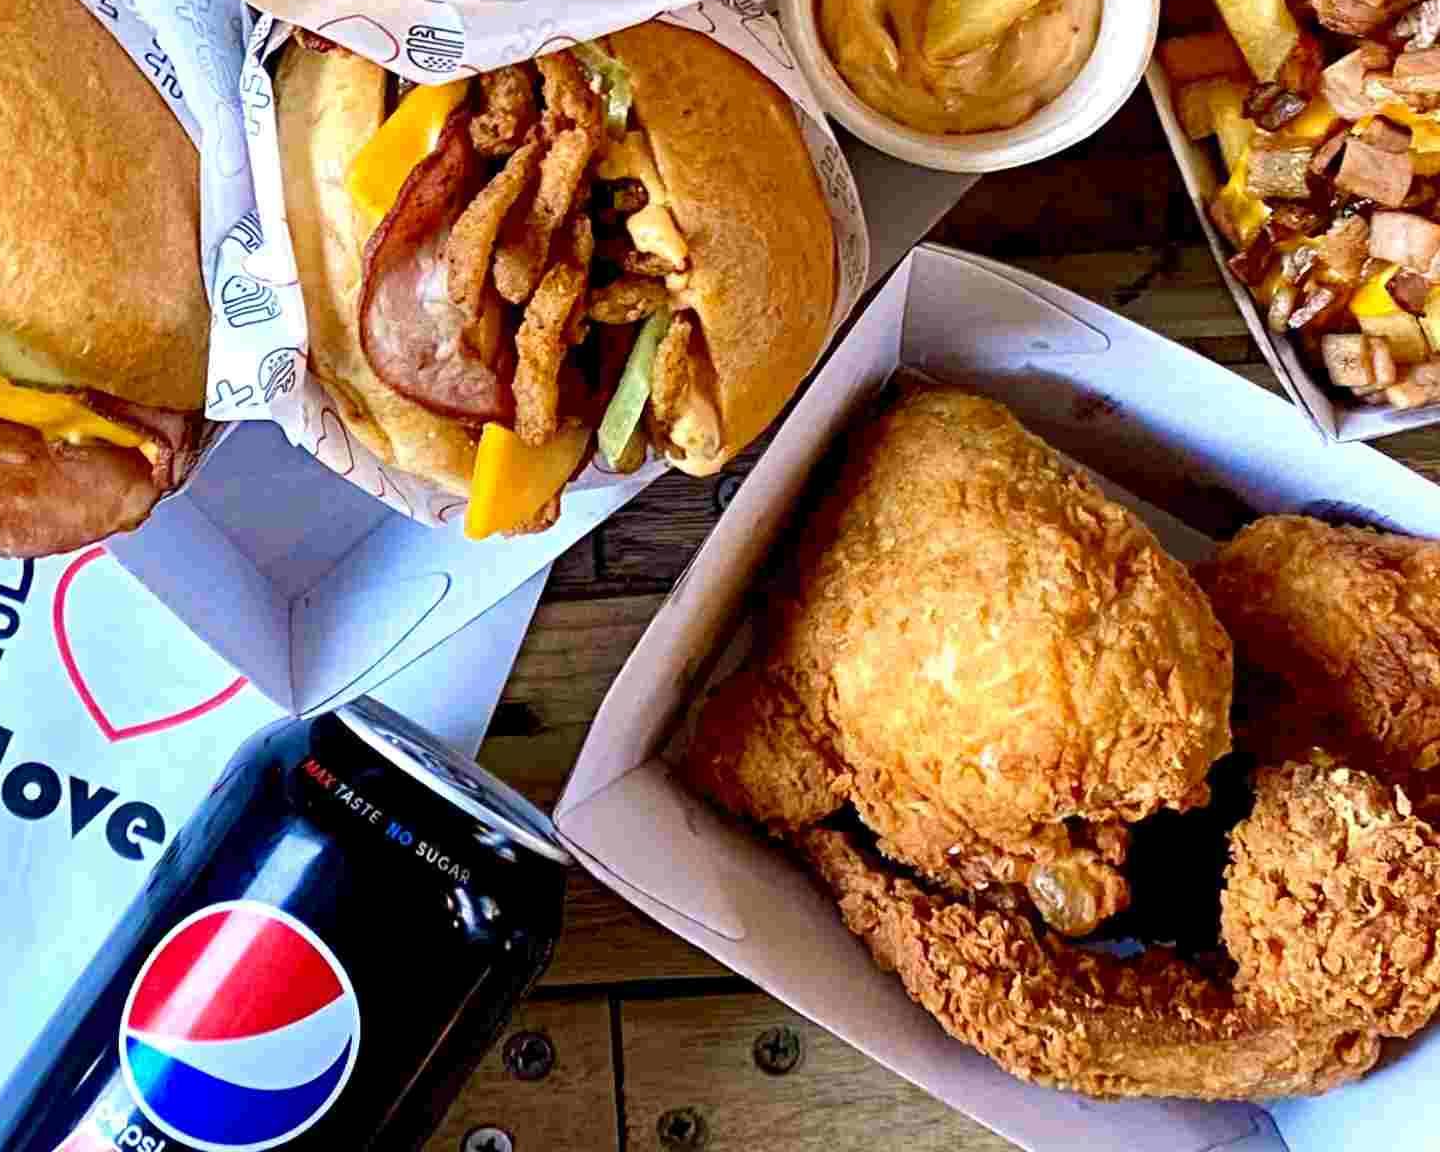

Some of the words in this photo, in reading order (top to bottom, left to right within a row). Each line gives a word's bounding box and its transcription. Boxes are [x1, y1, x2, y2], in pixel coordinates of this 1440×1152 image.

[303, 759, 336, 788] MAX
[335, 783, 383, 825] TASTE
[385, 821, 414, 846] NO
[415, 840, 471, 884] SUGAR
